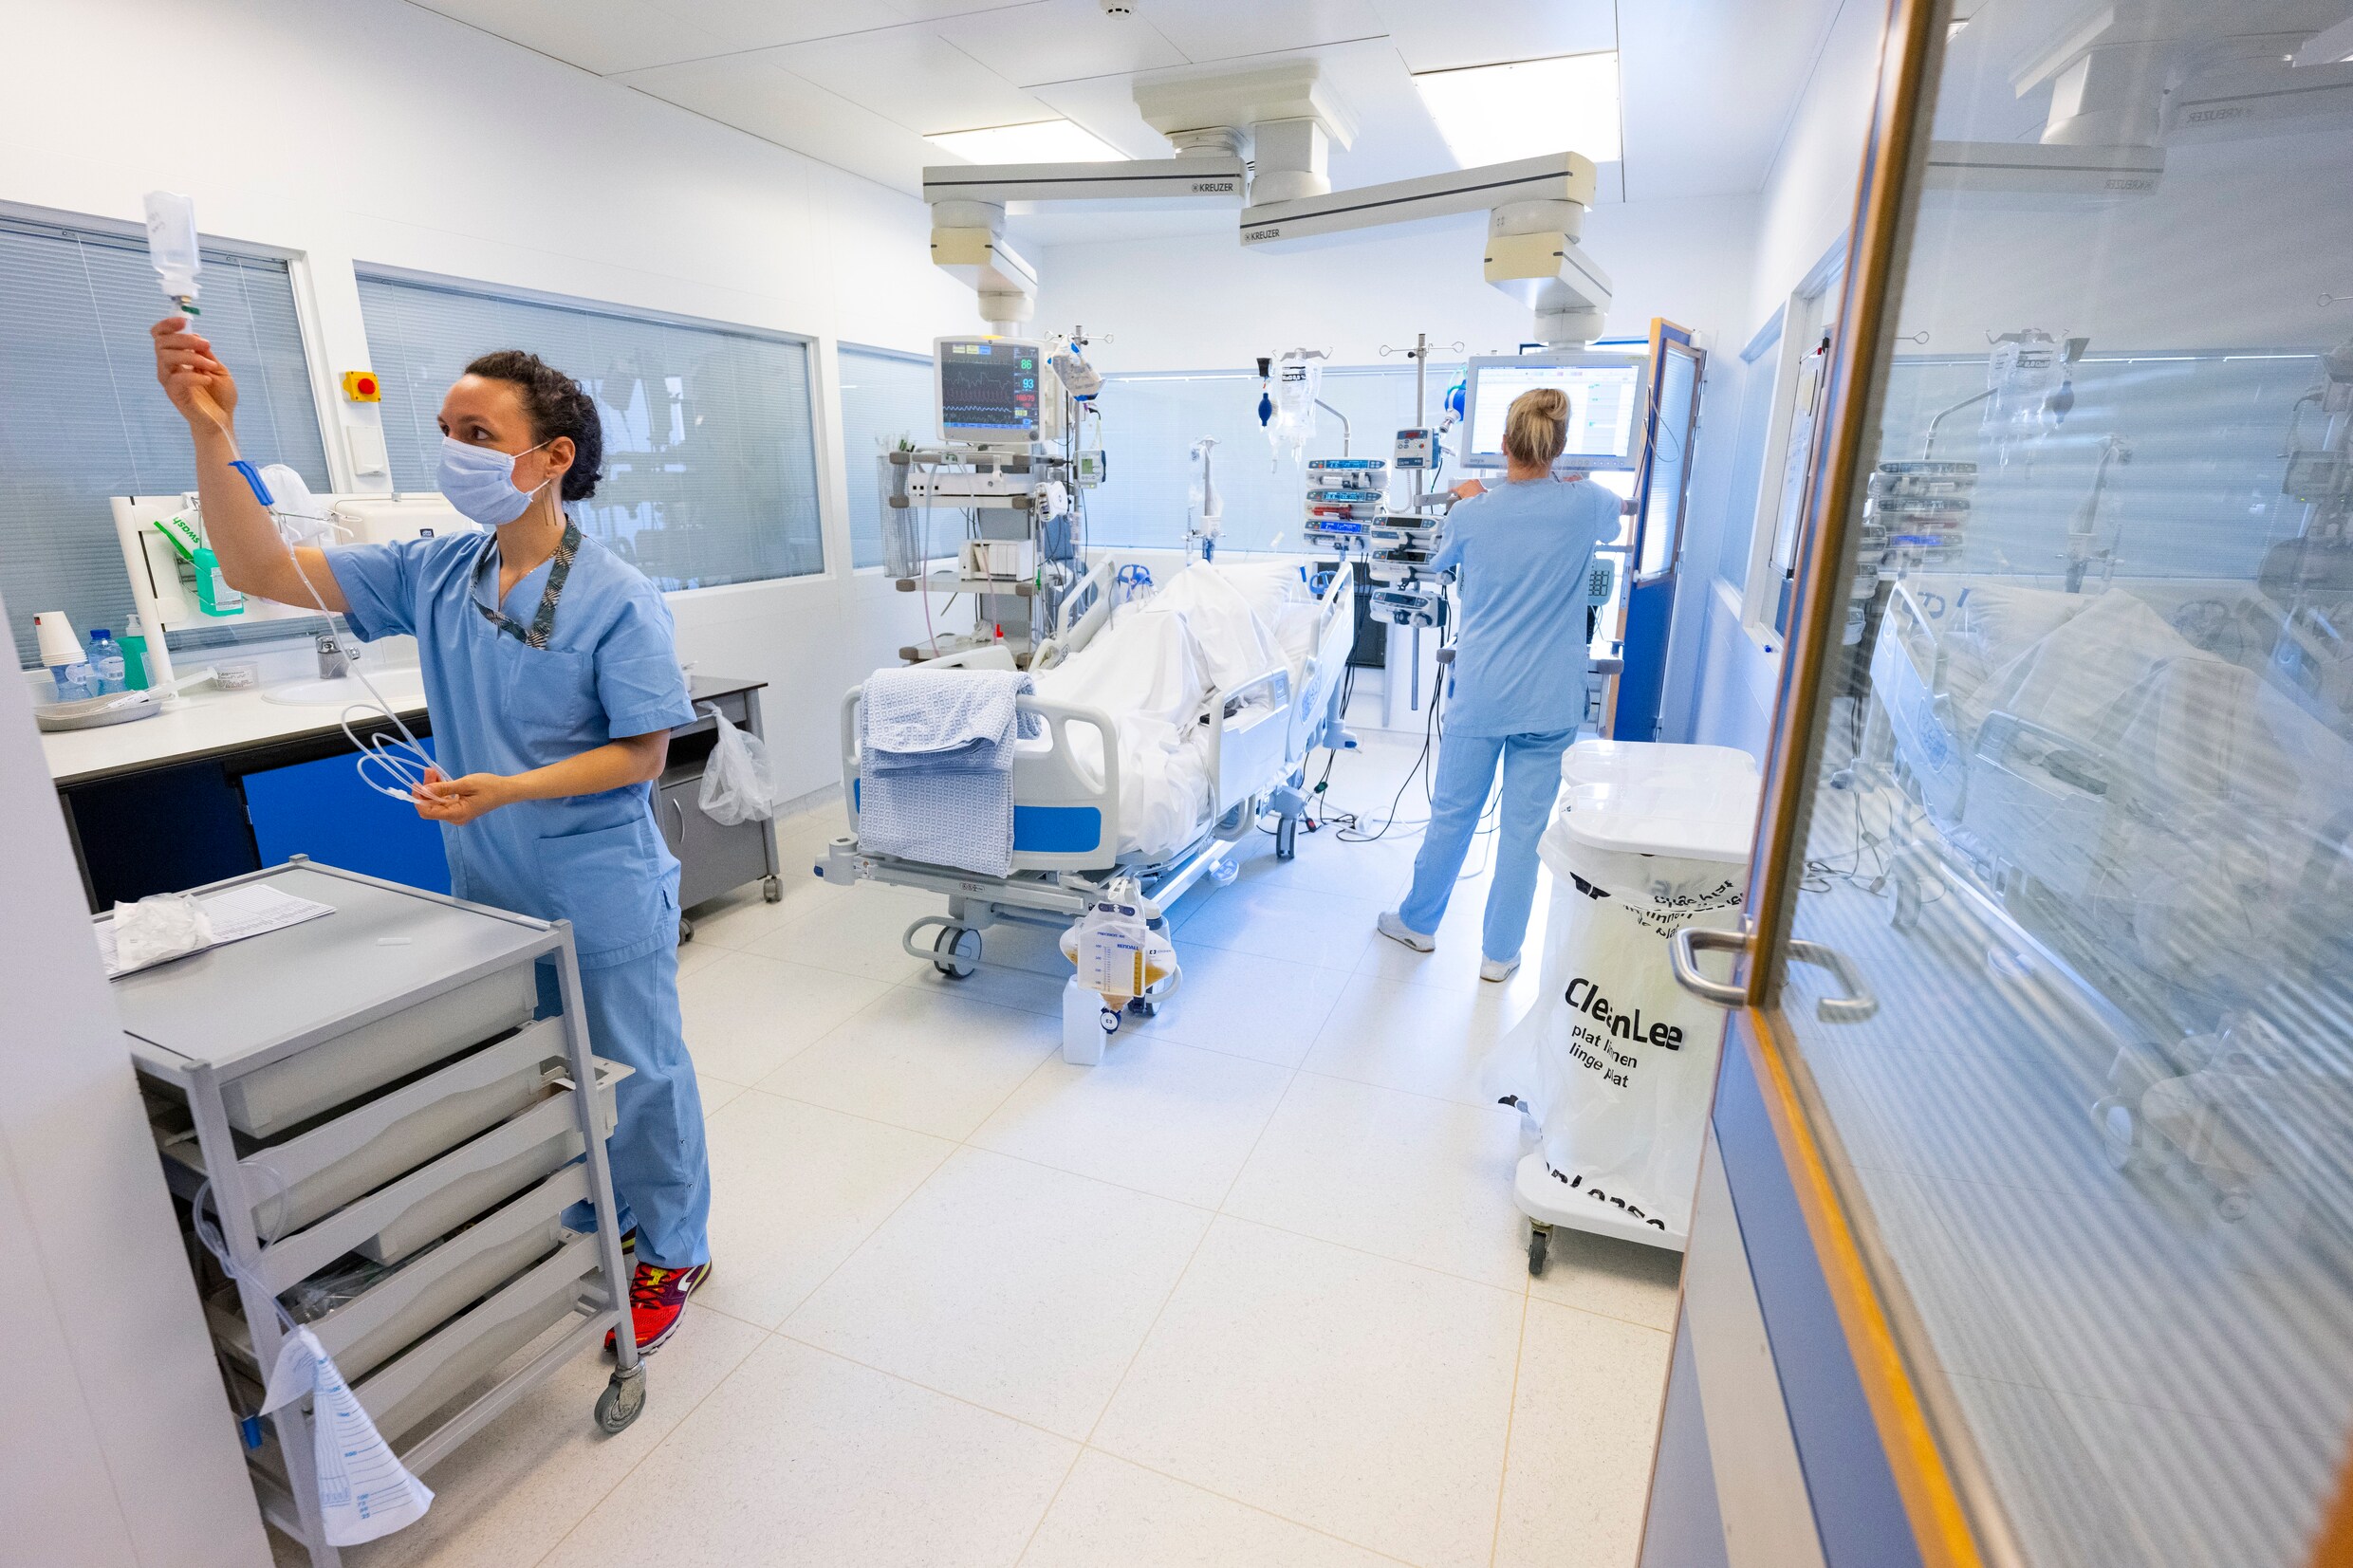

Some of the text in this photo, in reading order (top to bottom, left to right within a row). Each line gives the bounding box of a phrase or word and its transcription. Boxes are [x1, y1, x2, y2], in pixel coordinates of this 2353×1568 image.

[1199, 183, 1233, 193] KREUZER
[1251, 229, 1280, 241] KREUZER
[1021, 360, 1032, 370] 86
[1023, 378, 1034, 389] 93
[173, 516, 200, 544] swash
[1571, 1025, 1602, 1047] plat
[1569, 1042, 1603, 1069] linge
